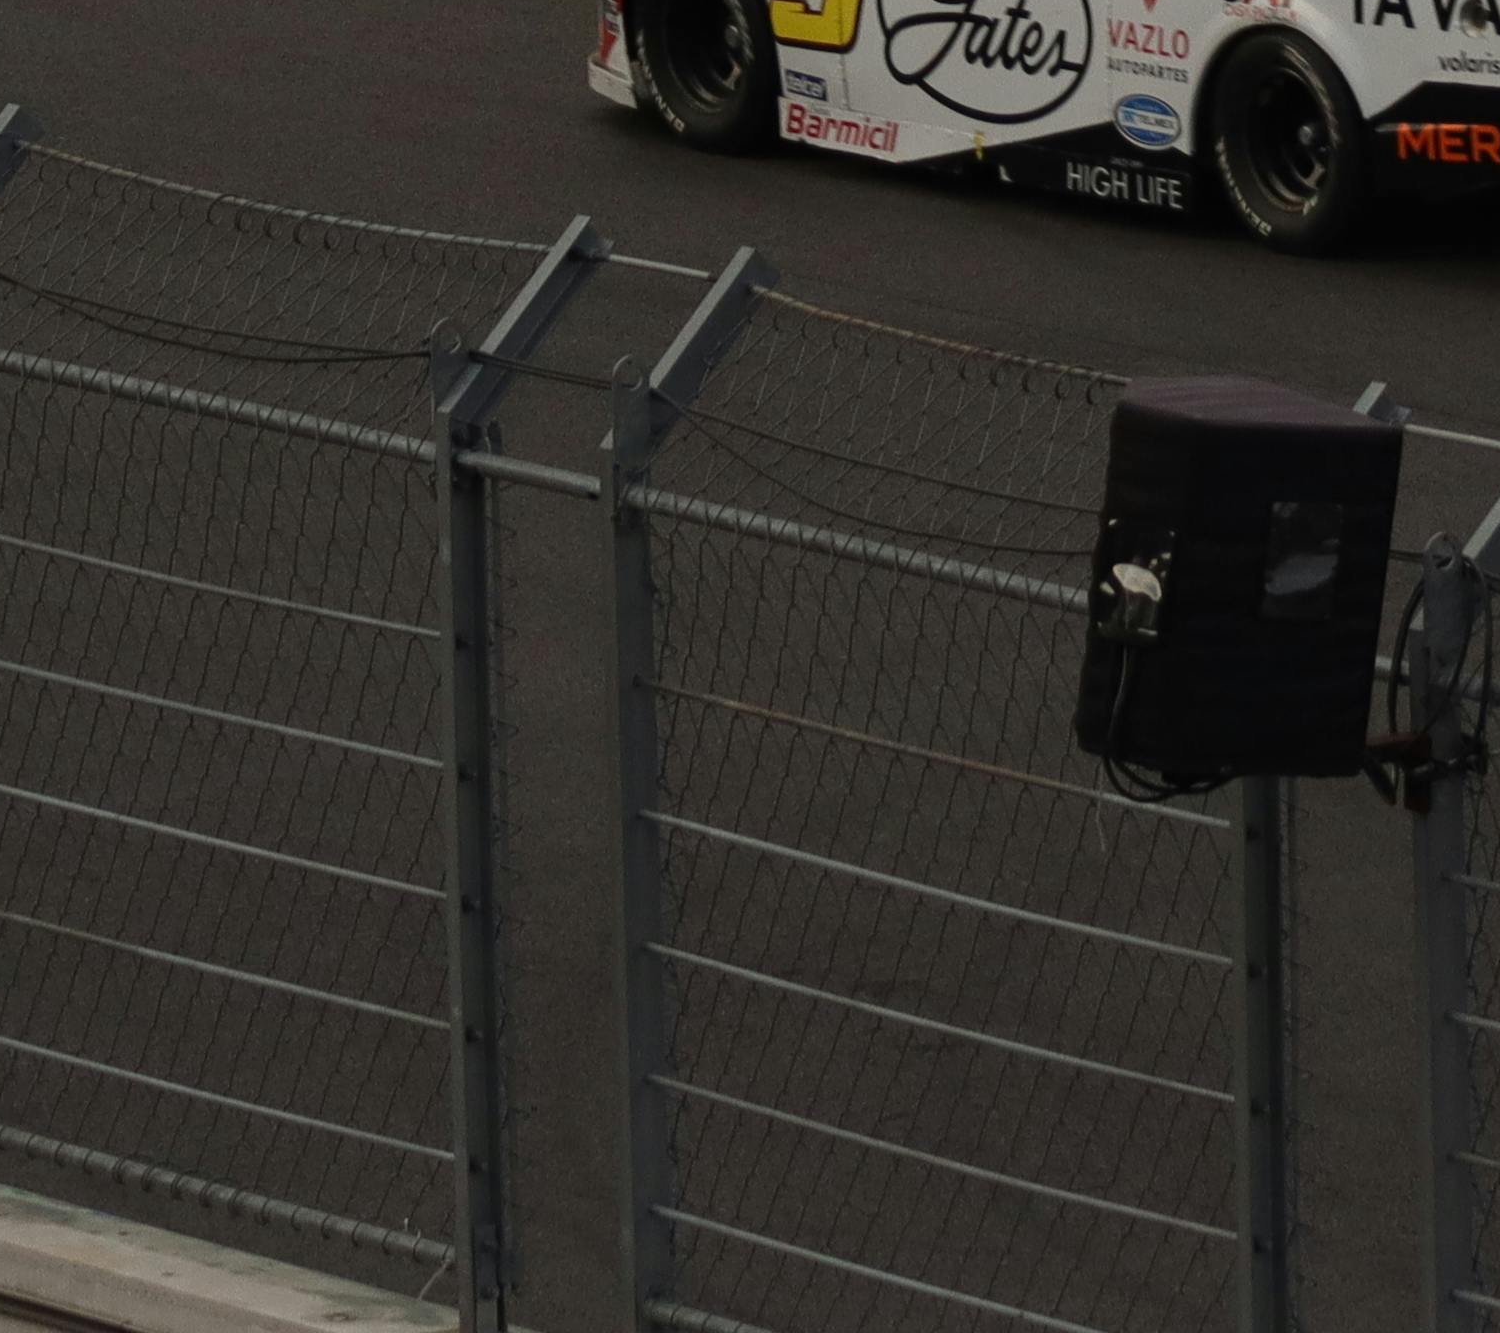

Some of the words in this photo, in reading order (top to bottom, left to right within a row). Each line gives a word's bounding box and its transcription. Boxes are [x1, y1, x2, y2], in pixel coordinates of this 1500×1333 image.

[1106, 16, 1191, 61] VAZLO
[785, 102, 901, 154] Barmicil
[1065, 160, 1131, 203] HIGH
[1136, 173, 1184, 211] LIFE
